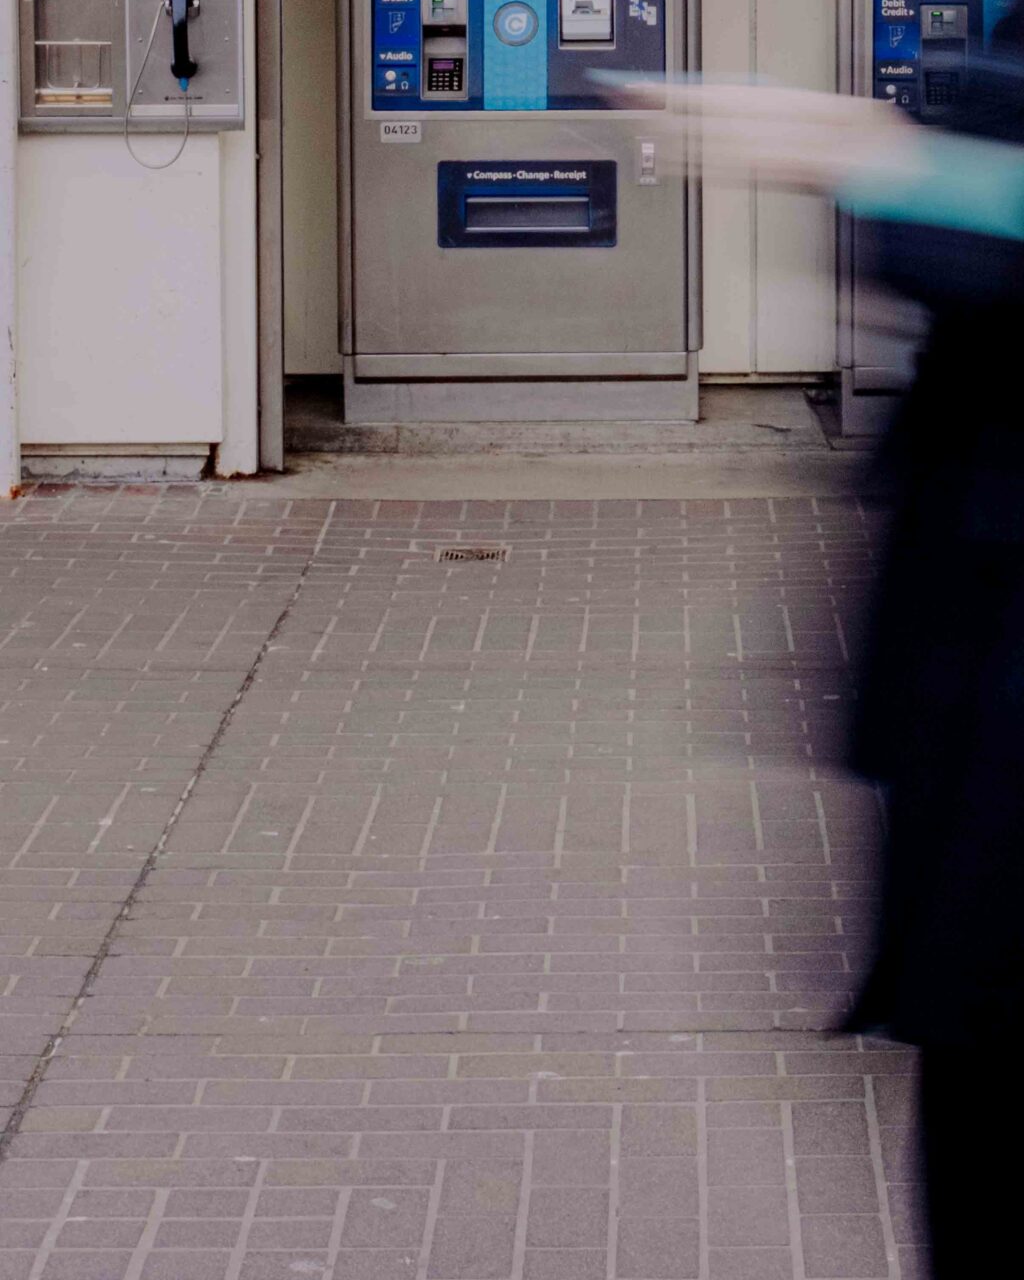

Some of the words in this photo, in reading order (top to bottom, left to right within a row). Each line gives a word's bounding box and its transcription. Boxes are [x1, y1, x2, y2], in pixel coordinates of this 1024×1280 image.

[881, 0, 905, 8] Debit
[881, 9, 908, 17] Credit
[387, 52, 413, 60] Audio
[886, 66, 913, 74] Audio
[384, 124, 418, 135] 04123
